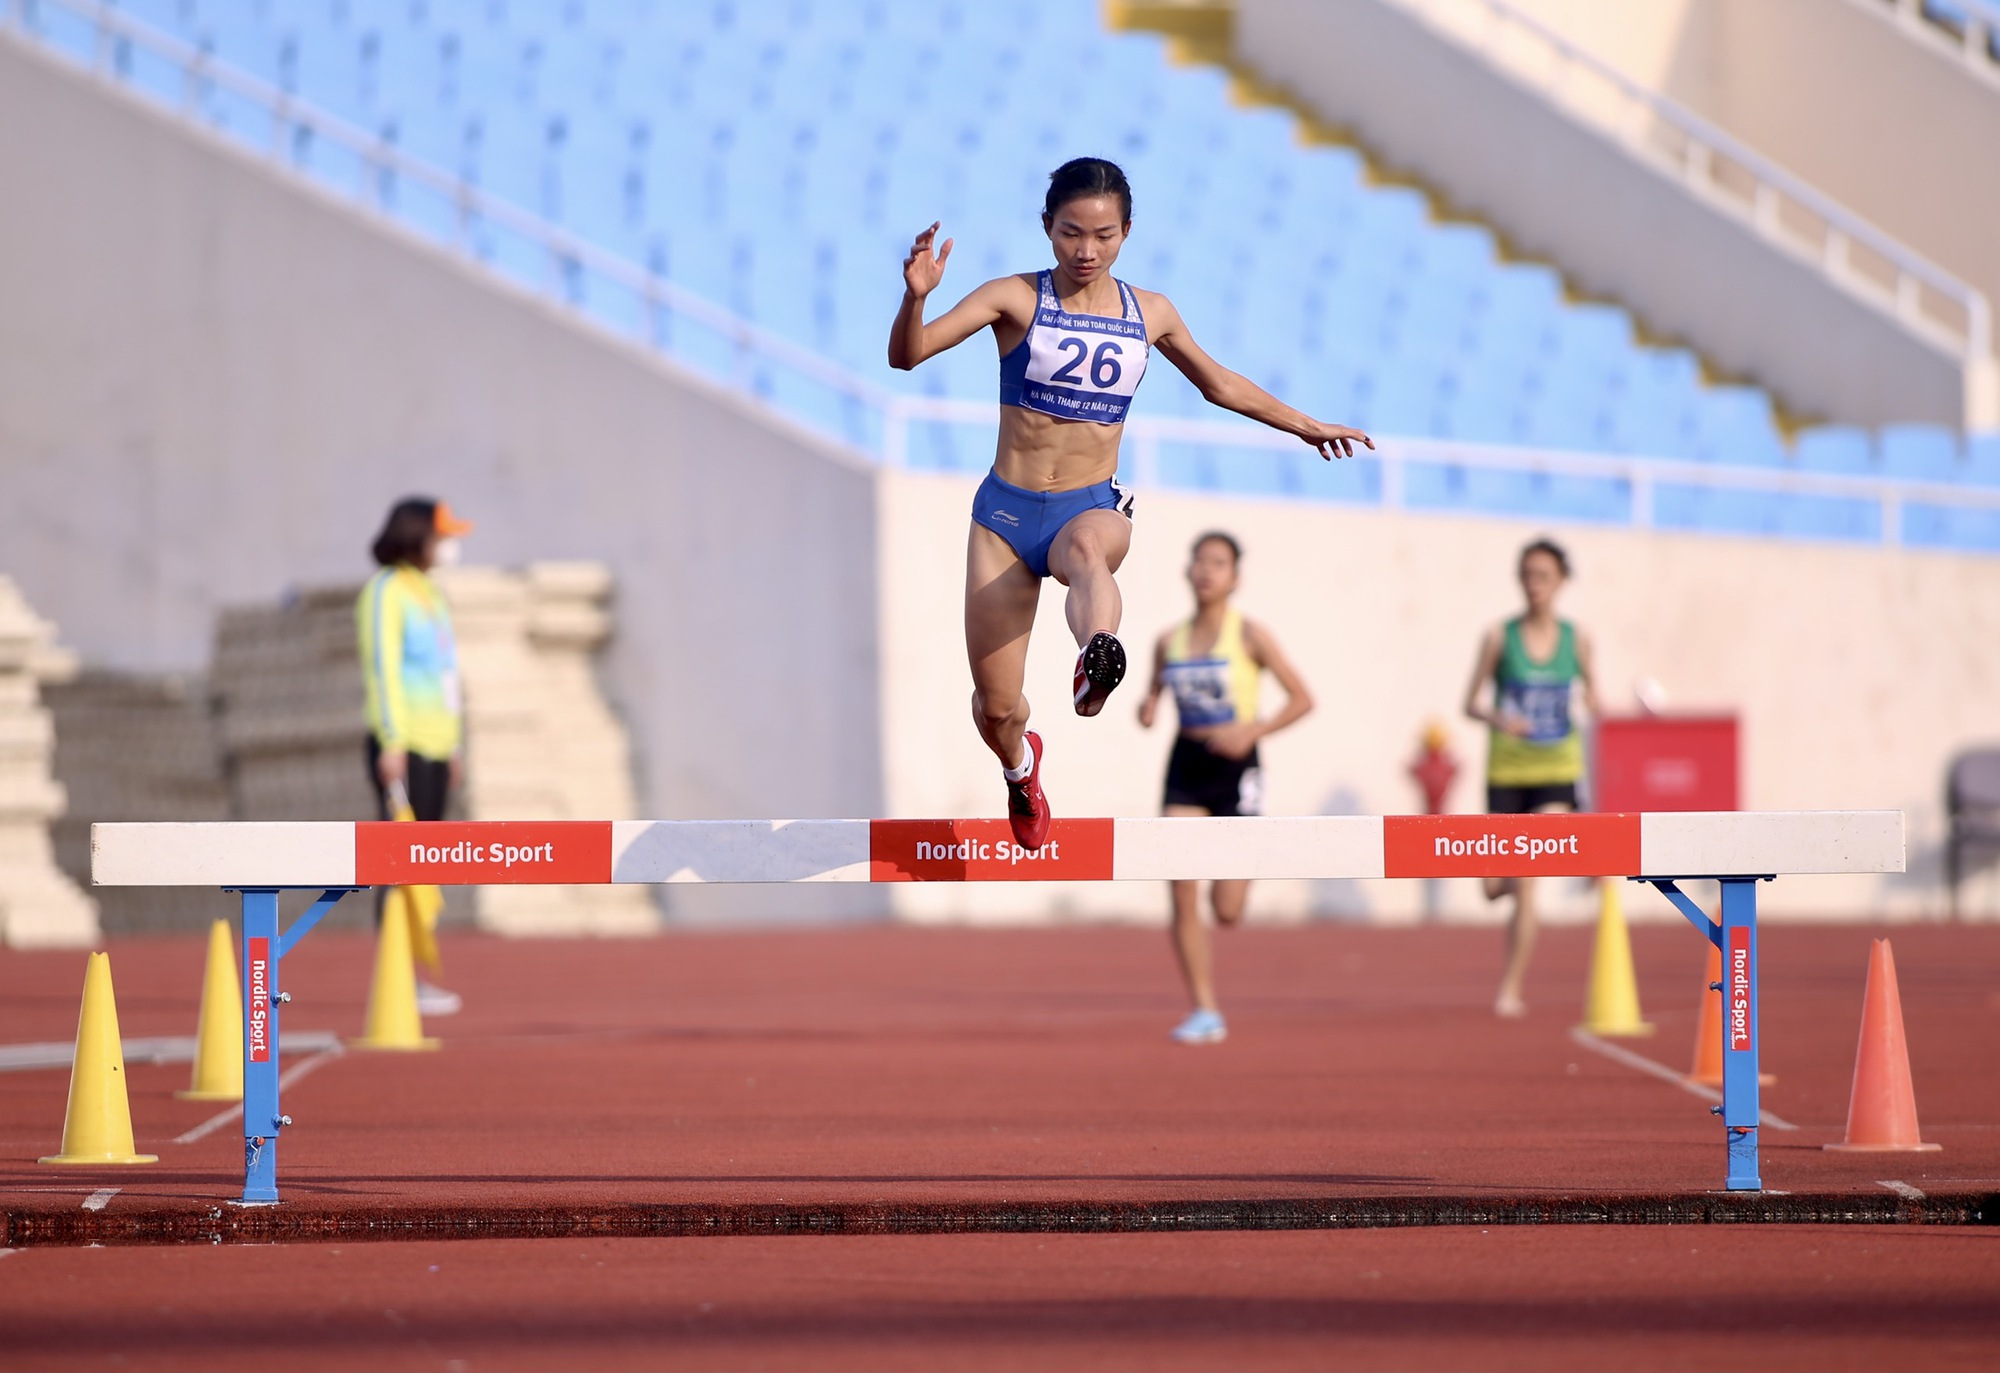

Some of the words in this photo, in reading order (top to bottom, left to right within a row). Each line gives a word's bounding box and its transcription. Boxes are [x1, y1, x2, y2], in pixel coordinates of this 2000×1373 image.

[1073, 319, 1090, 329] THAO
[1091, 319, 1106, 330] TOÀN
[1050, 337, 1123, 389] 26
[1058, 396, 1081, 409] THÁNG
[1082, 402, 1090, 410] 12
[1091, 401, 1108, 411] NĂM
[489, 842, 554, 868] Sport
[995, 840, 1060, 865] Sport
[1514, 834, 1579, 860] Sport
[250, 1010, 266, 1052] Sport
[1732, 999, 1747, 1040] Sport
